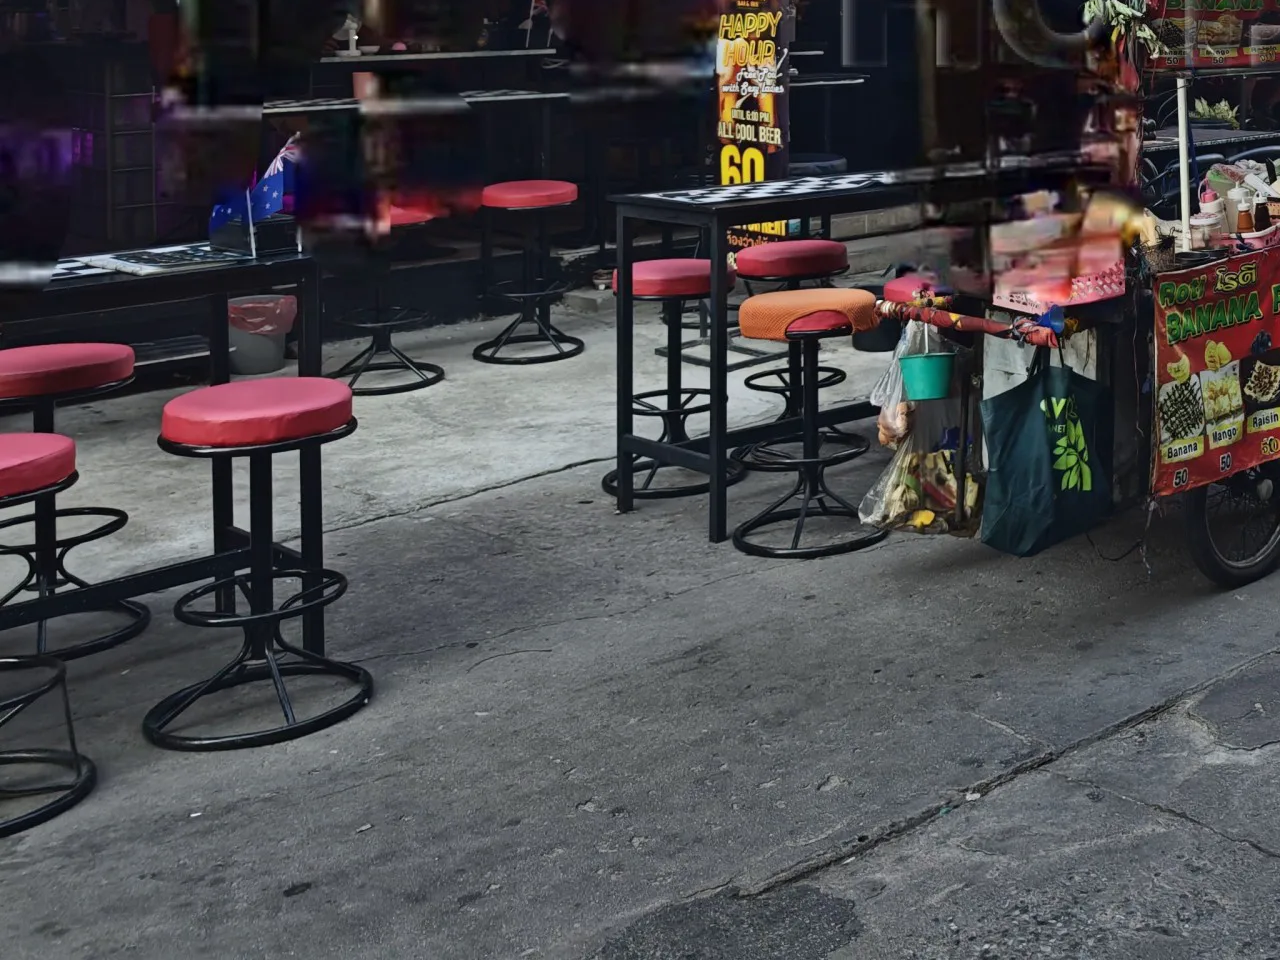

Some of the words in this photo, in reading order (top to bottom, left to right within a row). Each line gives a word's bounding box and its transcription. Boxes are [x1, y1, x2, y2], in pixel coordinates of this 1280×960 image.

[719, 11, 783, 39] HAPPY
[722, 40, 776, 68] HOUR
[1166, 56, 1179, 65] 50
[1212, 56, 1224, 65] 50
[731, 109, 745, 120] UNTIL
[745, 109, 760, 121] 6:00
[760, 111, 771, 122] PM
[718, 121, 735, 139] ALL
[735, 123, 758, 141] COOL
[759, 127, 782, 145] BEER
[721, 144, 766, 185] 60
[1159, 274, 1207, 308] Roti
[1165, 290, 1264, 345] BANANA
[1252, 412, 1280, 429] Raisin
[1211, 427, 1238, 444] Mango
[1167, 441, 1199, 460] Banana
[1219, 451, 1233, 472] 50
[1172, 467, 1189, 488] 50
